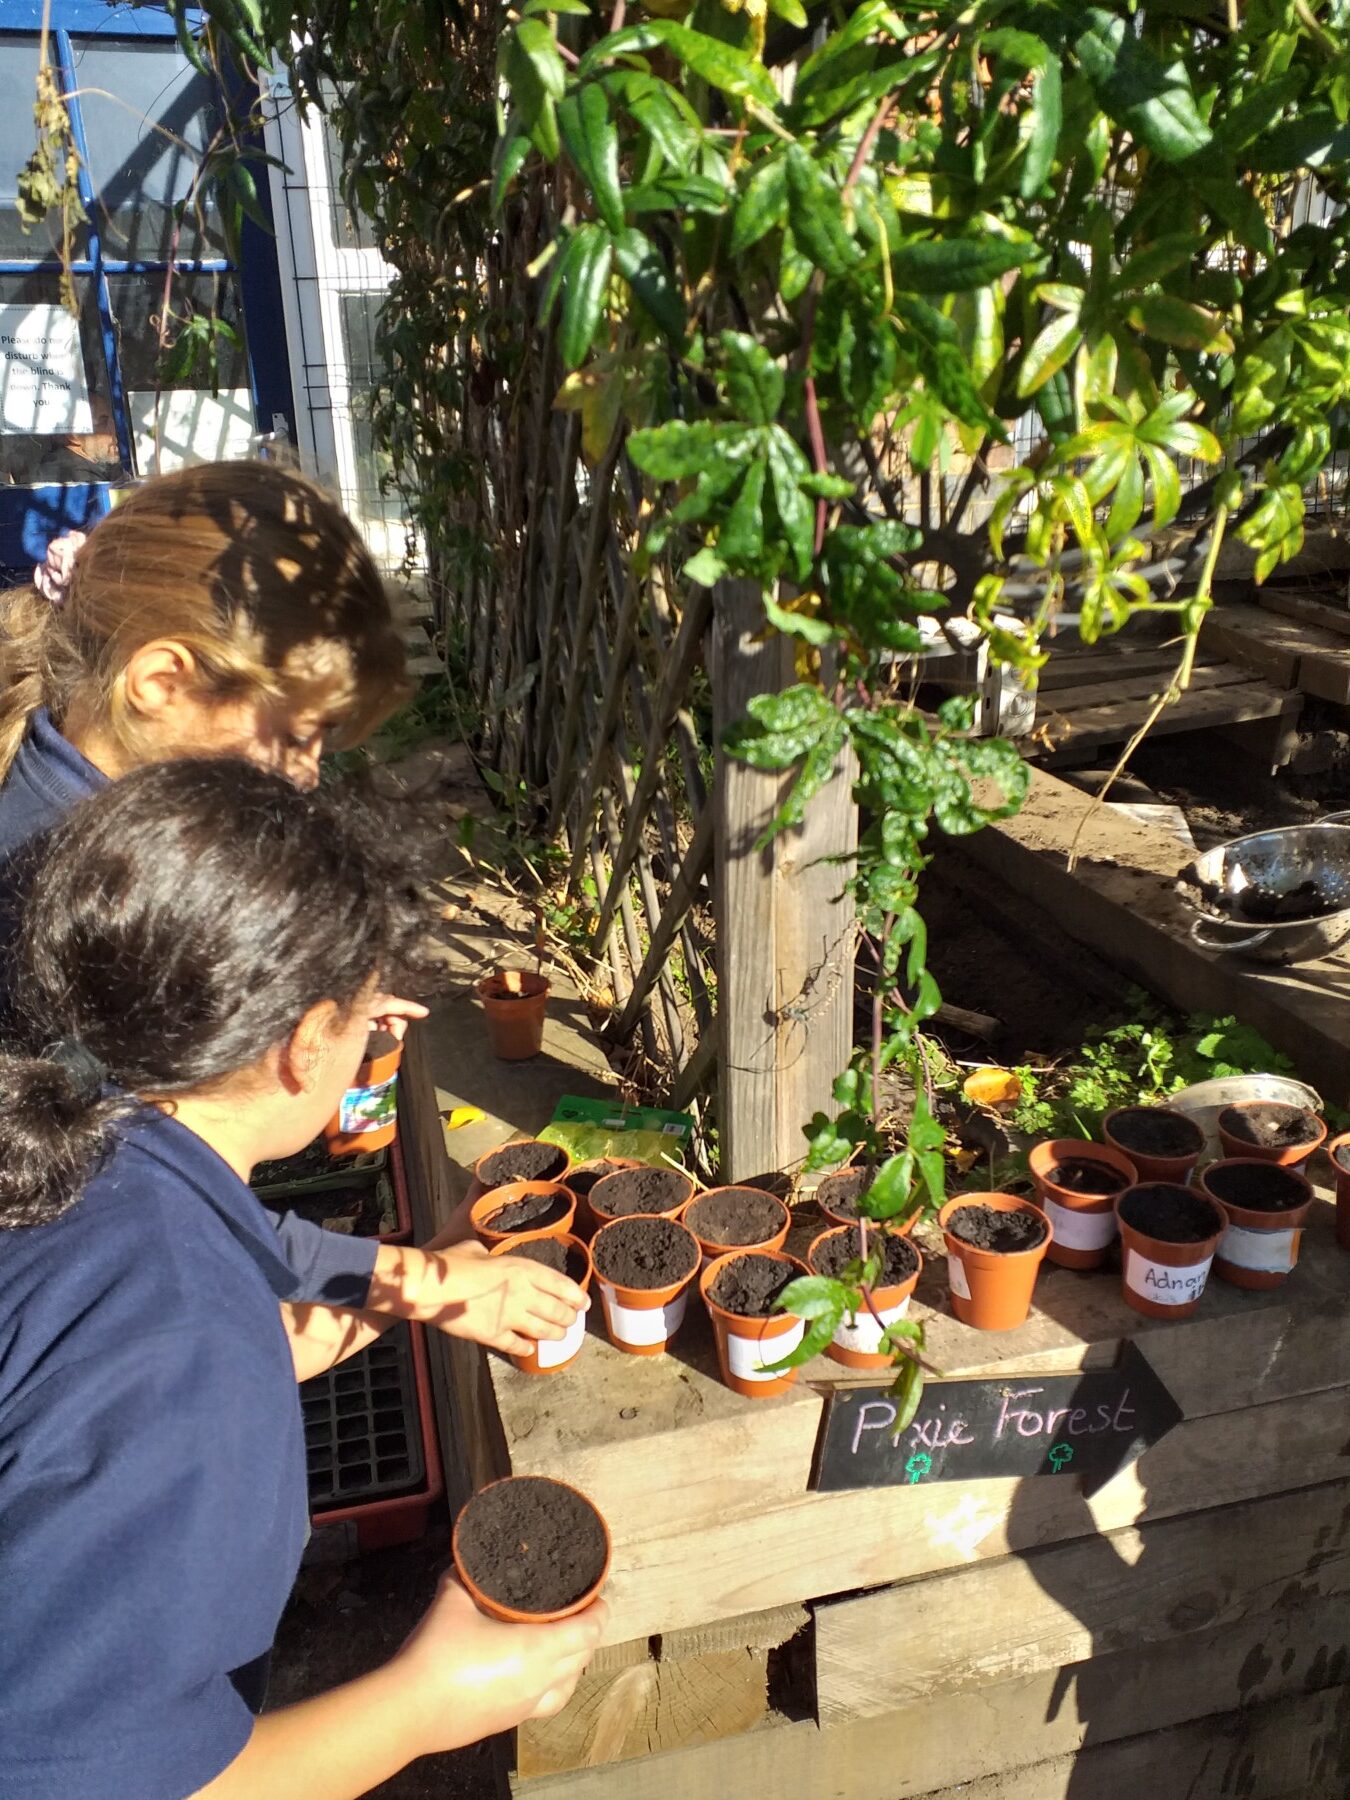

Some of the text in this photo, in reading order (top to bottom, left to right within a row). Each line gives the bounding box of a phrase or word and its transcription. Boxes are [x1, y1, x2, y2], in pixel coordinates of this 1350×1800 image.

[5, 351, 67, 360] disturb wh
[30, 366, 54, 375] blind
[42, 382, 71, 391] Thank
[995, 1388, 1135, 1440] Forest
